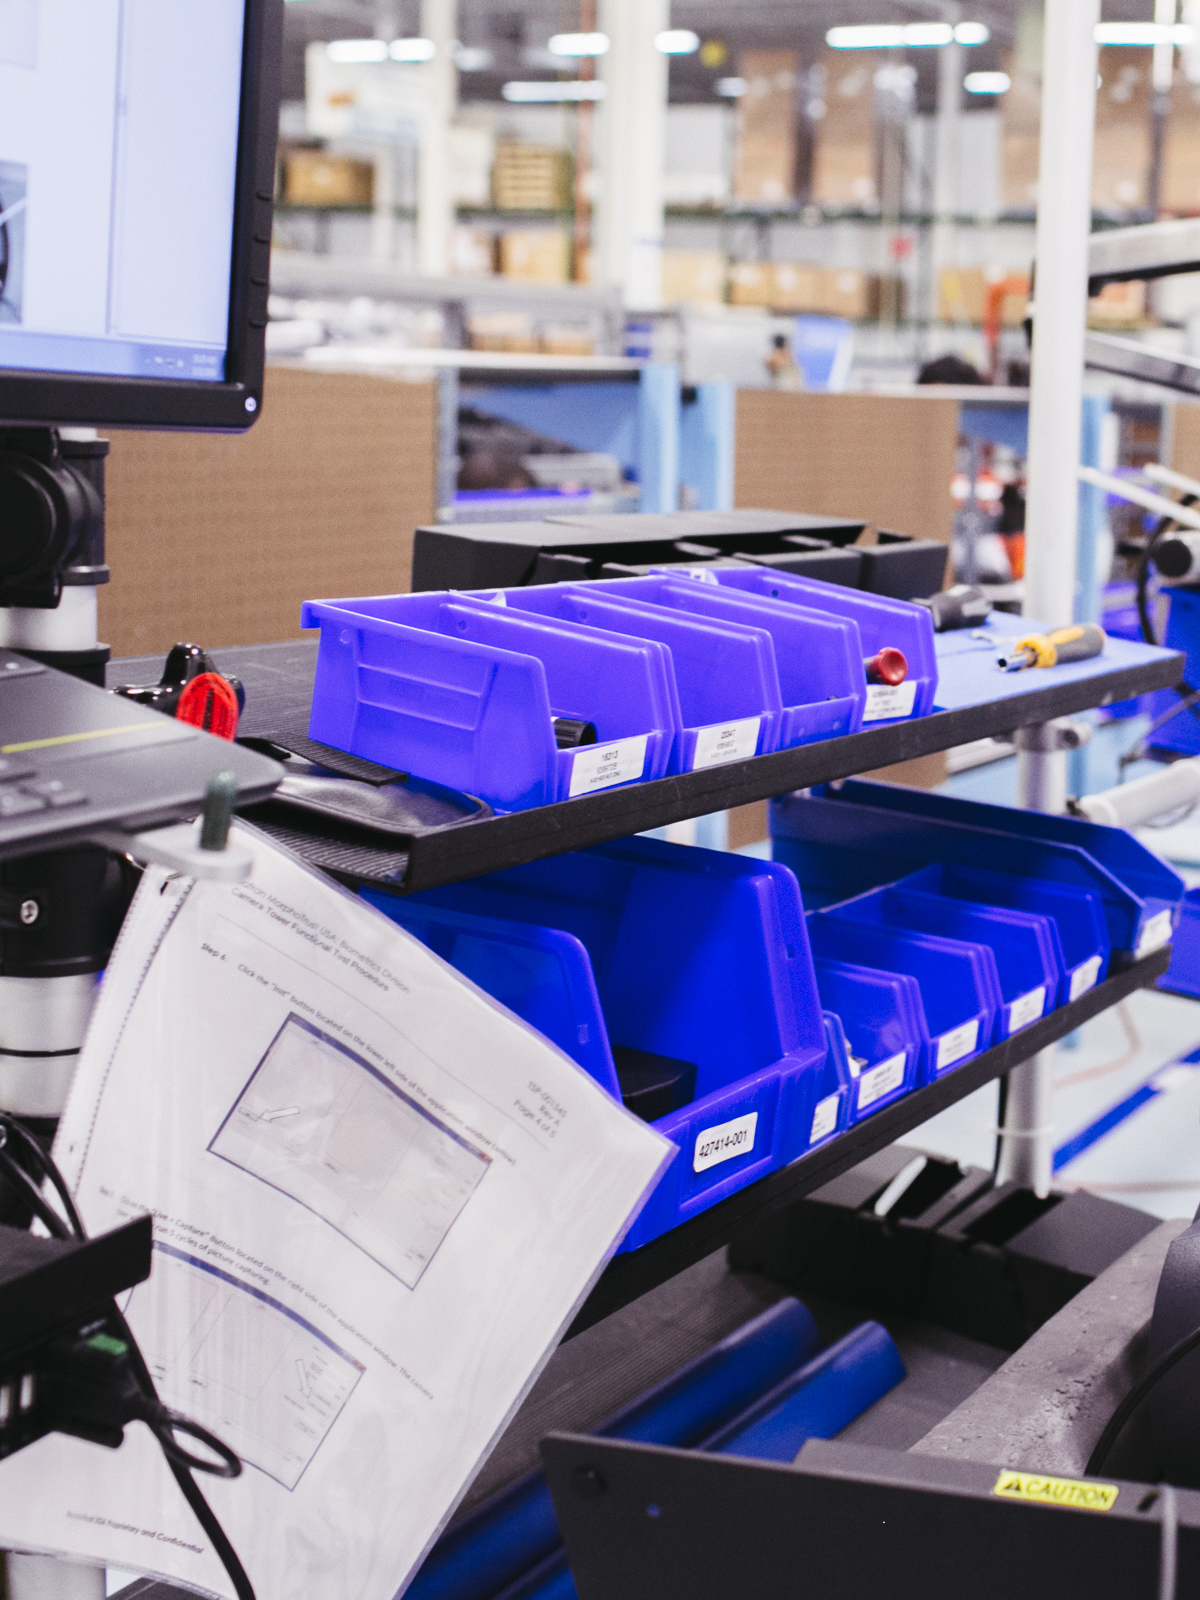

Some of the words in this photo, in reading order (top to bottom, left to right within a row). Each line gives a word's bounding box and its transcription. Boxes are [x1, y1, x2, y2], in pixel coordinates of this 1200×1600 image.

[231, 887, 264, 911] Camera
[265, 906, 290, 926] Tower
[290, 922, 333, 952] Functional
[332, 949, 351, 965] Test
[350, 960, 390, 992] Procedure
[339, 940, 382, 972] Biometrics
[381, 968, 410, 994] Division
[201, 942, 219, 957] Step
[237, 963, 255, 977] Click
[256, 974, 269, 986] the
[290, 995, 315, 1015] button
[315, 1010, 344, 1032] located
[342, 1029, 353, 1039] on
[353, 1035, 365, 1047] the
[366, 1044, 384, 1061] lower
[384, 1058, 396, 1071] left
[395, 1070, 408, 1082] side
[408, 1080, 417, 1089] of
[416, 1086, 427, 1098] the
[428, 1097, 464, 1126] application
[513, 1099, 535, 1119] Page
[699, 1129, 748, 1158] 427414-001
[154, 1225, 169, 1234] run
[175, 1233, 198, 1249] cycles
[198, 1242, 208, 1251] of
[207, 1247, 234, 1266] picture
[209, 1235, 235, 1253] Button
[236, 1247, 264, 1268] located
[263, 1264, 274, 1274] on
[274, 1270, 287, 1282] the
[288, 1280, 304, 1294] right
[304, 1291, 318, 1303] side
[318, 1301, 328, 1309] of
[326, 1307, 337, 1319] the
[337, 1318, 373, 1347] application
[1026, 1480, 1112, 1504] CAUTION
[140, 1528, 156, 1539] and
[156, 1532, 204, 1554] Confidential
